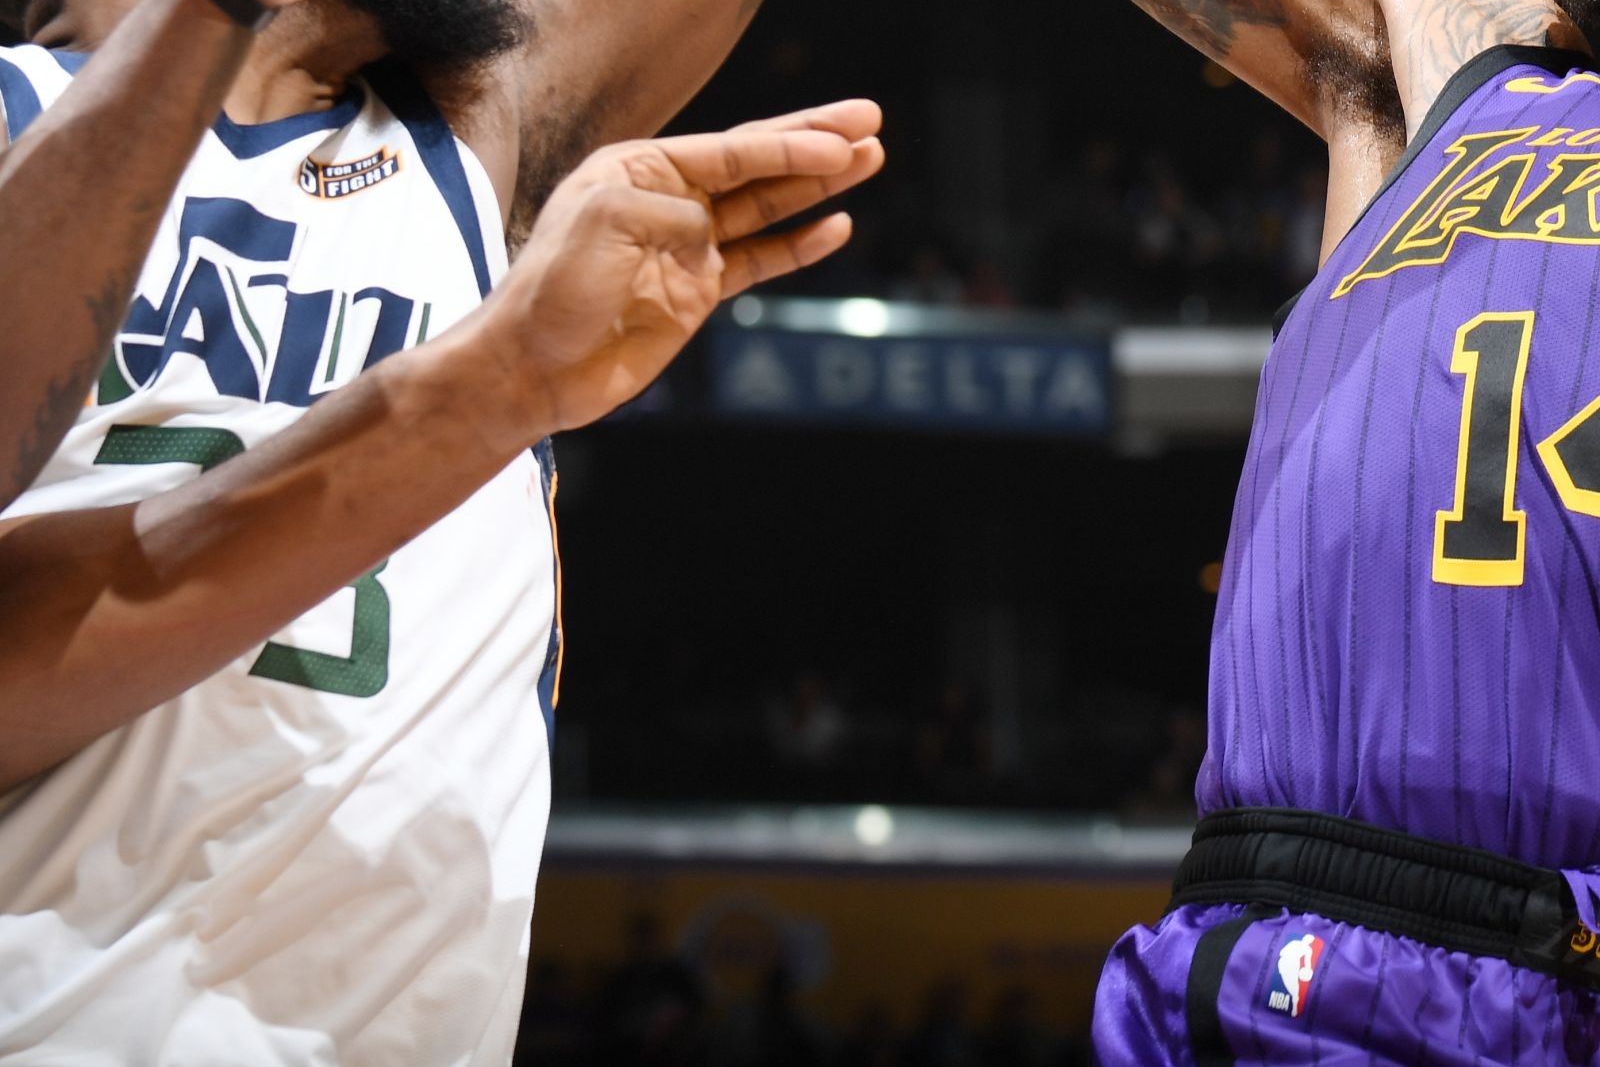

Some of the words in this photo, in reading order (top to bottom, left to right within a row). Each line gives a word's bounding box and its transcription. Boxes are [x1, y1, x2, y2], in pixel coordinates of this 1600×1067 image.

[326, 164, 352, 177] FOR
[355, 154, 379, 171] THE
[327, 159, 394, 197] FIGHT
[814, 344, 1107, 416] DELTA
[1268, 990, 1291, 1012] NBA
